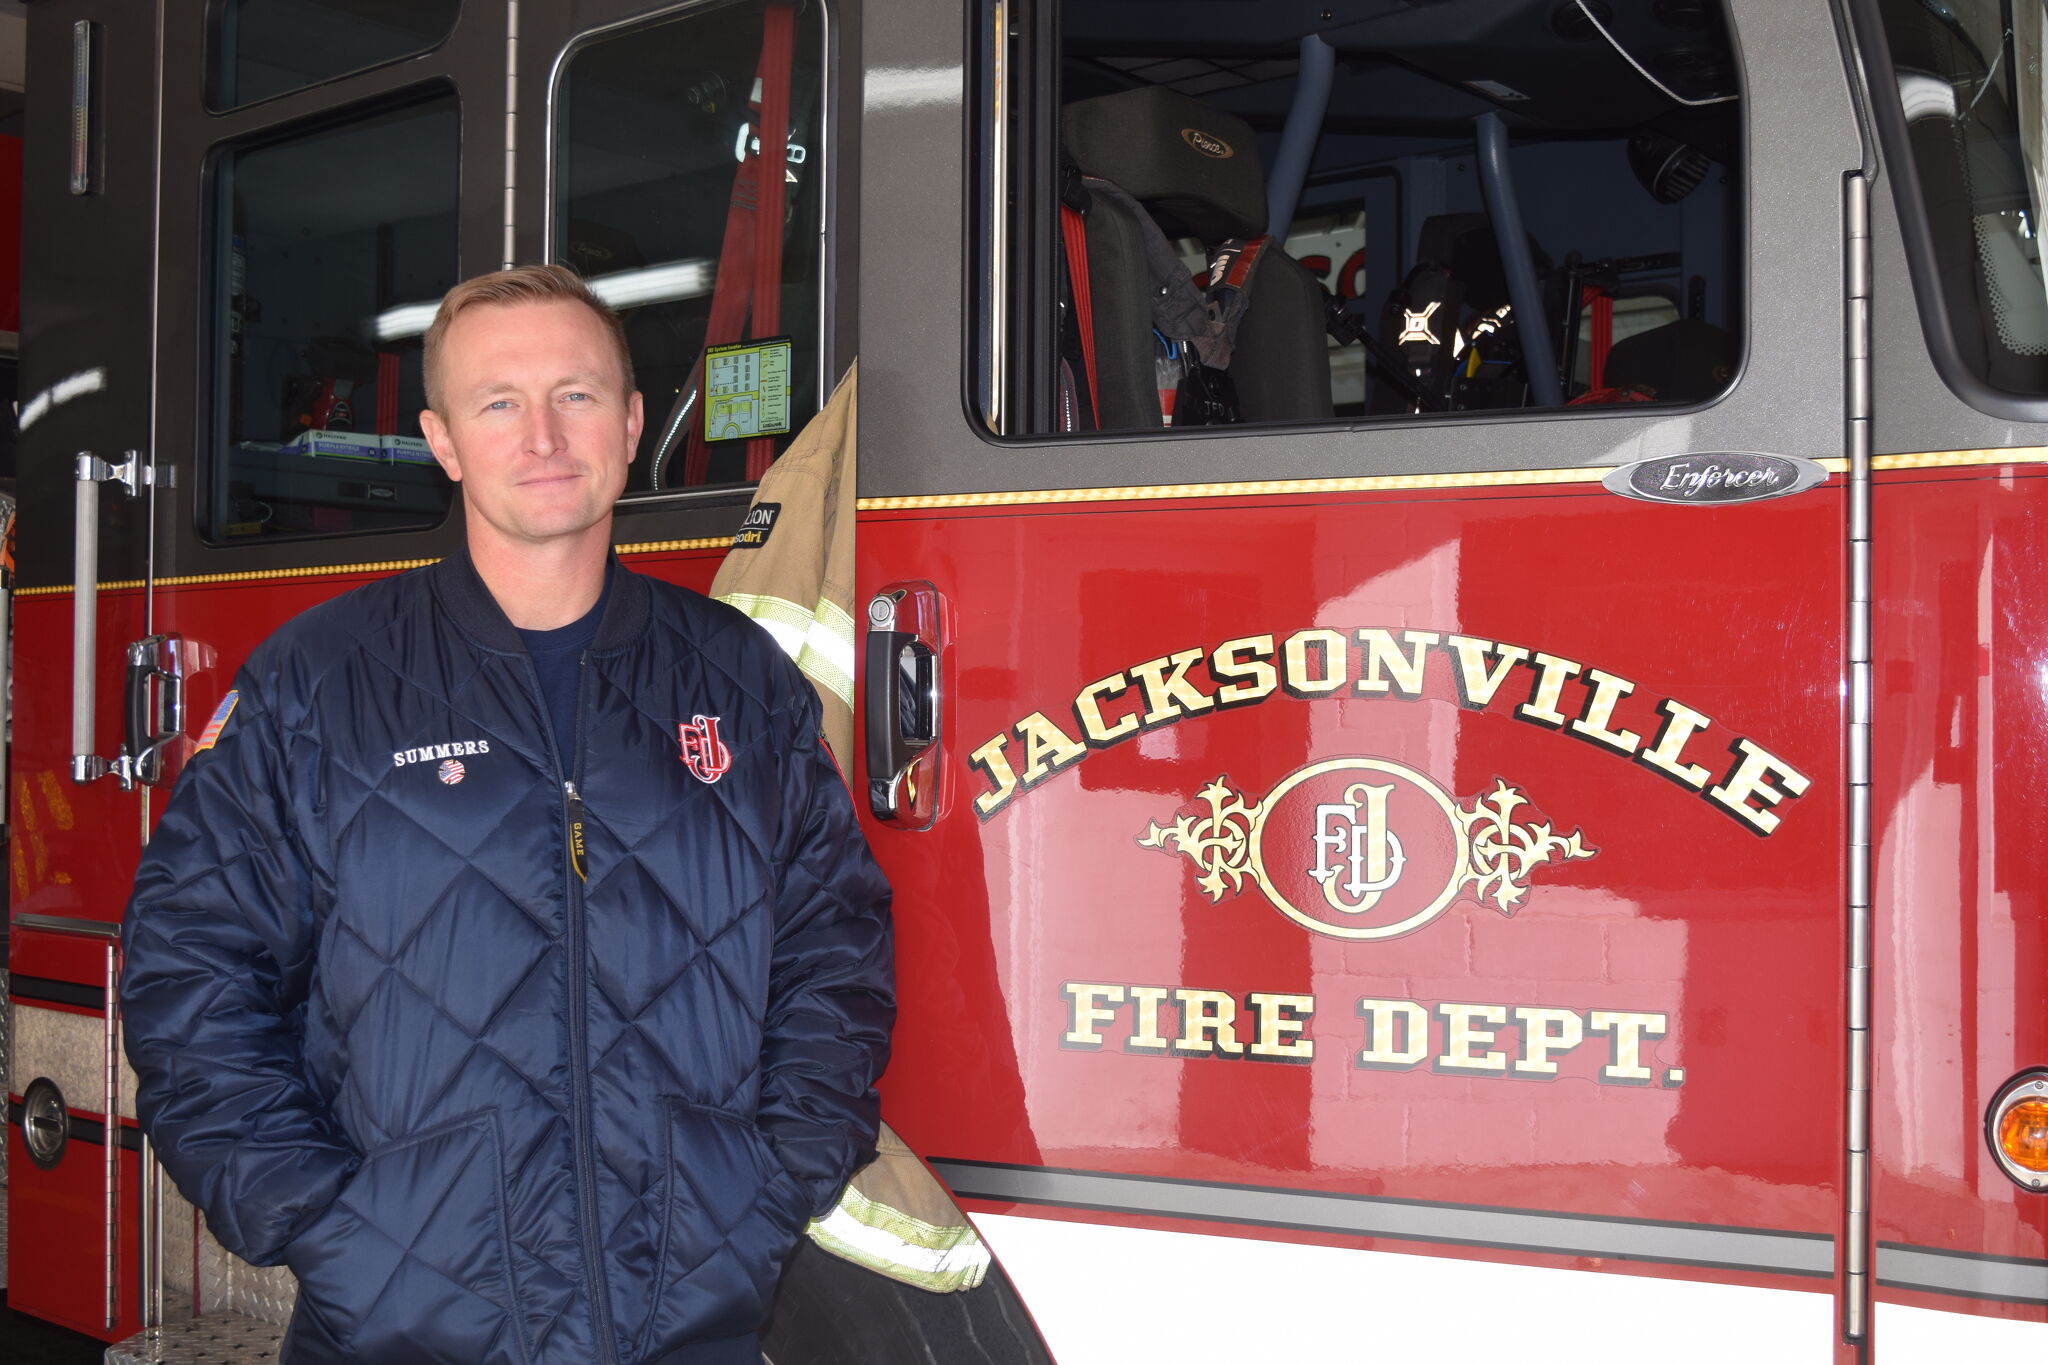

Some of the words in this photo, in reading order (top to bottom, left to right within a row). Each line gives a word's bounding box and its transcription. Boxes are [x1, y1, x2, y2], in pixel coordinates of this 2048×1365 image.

[1659, 463, 1779, 497] Enforcer
[744, 509, 773, 525] LION
[969, 628, 1811, 837] JACKSONVILLE
[393, 740, 490, 767] SUMMERS
[573, 822, 585, 856] GAME
[1061, 982, 1314, 1064] FIRE
[1357, 998, 1684, 1087] DEPT.
